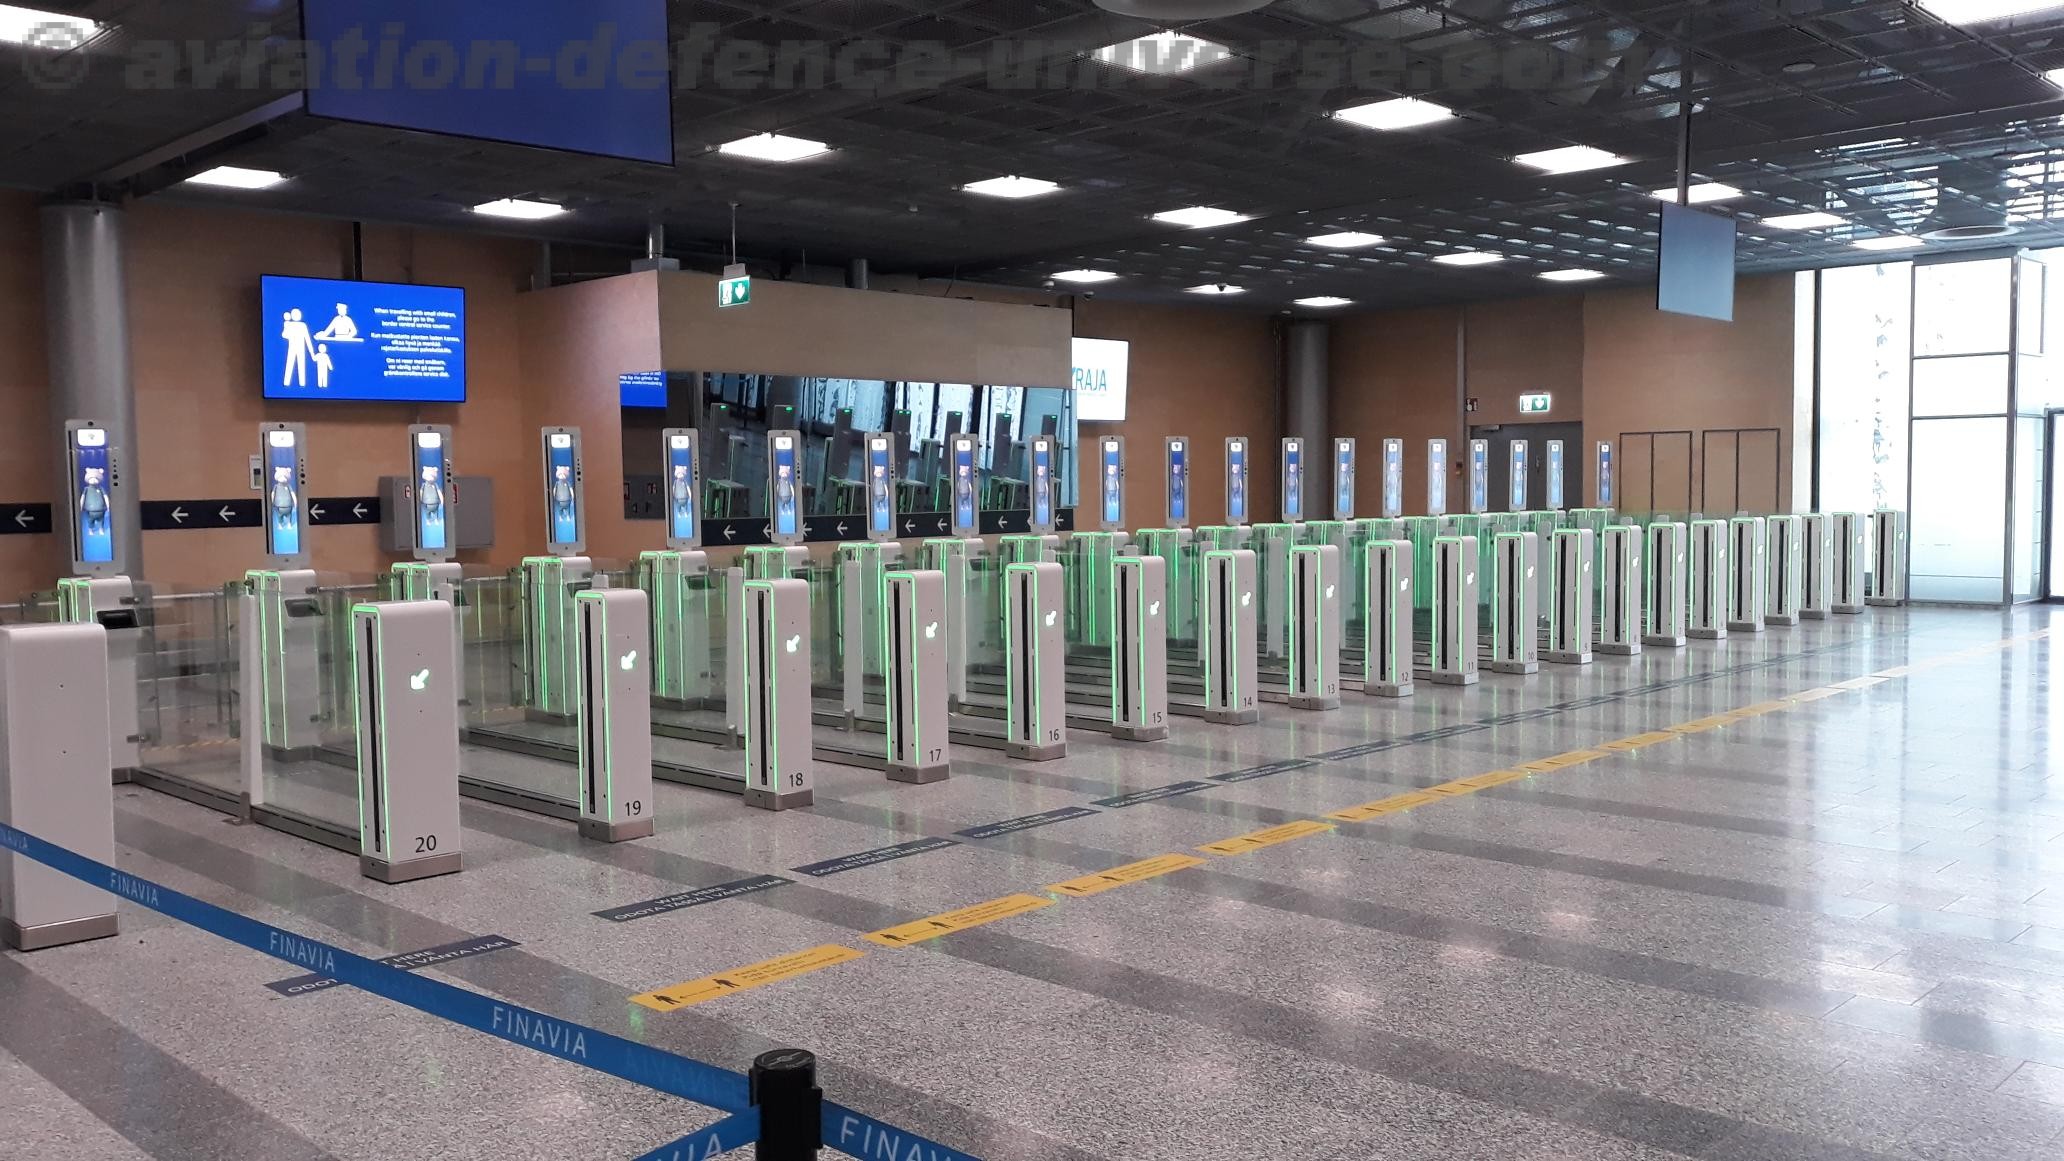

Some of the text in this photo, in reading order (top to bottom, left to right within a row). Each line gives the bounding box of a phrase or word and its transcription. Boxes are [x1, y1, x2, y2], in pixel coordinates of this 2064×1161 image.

[1401, 672, 1409, 682] 12
[1327, 684, 1335, 694] 13
[1243, 697, 1252, 707] 14
[1152, 711, 1162, 724] 15
[1049, 728, 1060, 741] 16
[929, 748, 942, 763] 17
[789, 772, 804, 788] 18
[624, 800, 642, 817] 19
[415, 834, 437, 853] 20
[110, 872, 159, 906] FINAVIA
[269, 931, 335, 973] FINAVIA
[392, 951, 435, 962] HERE
[492, 1006, 587, 1058] FINAVIA
